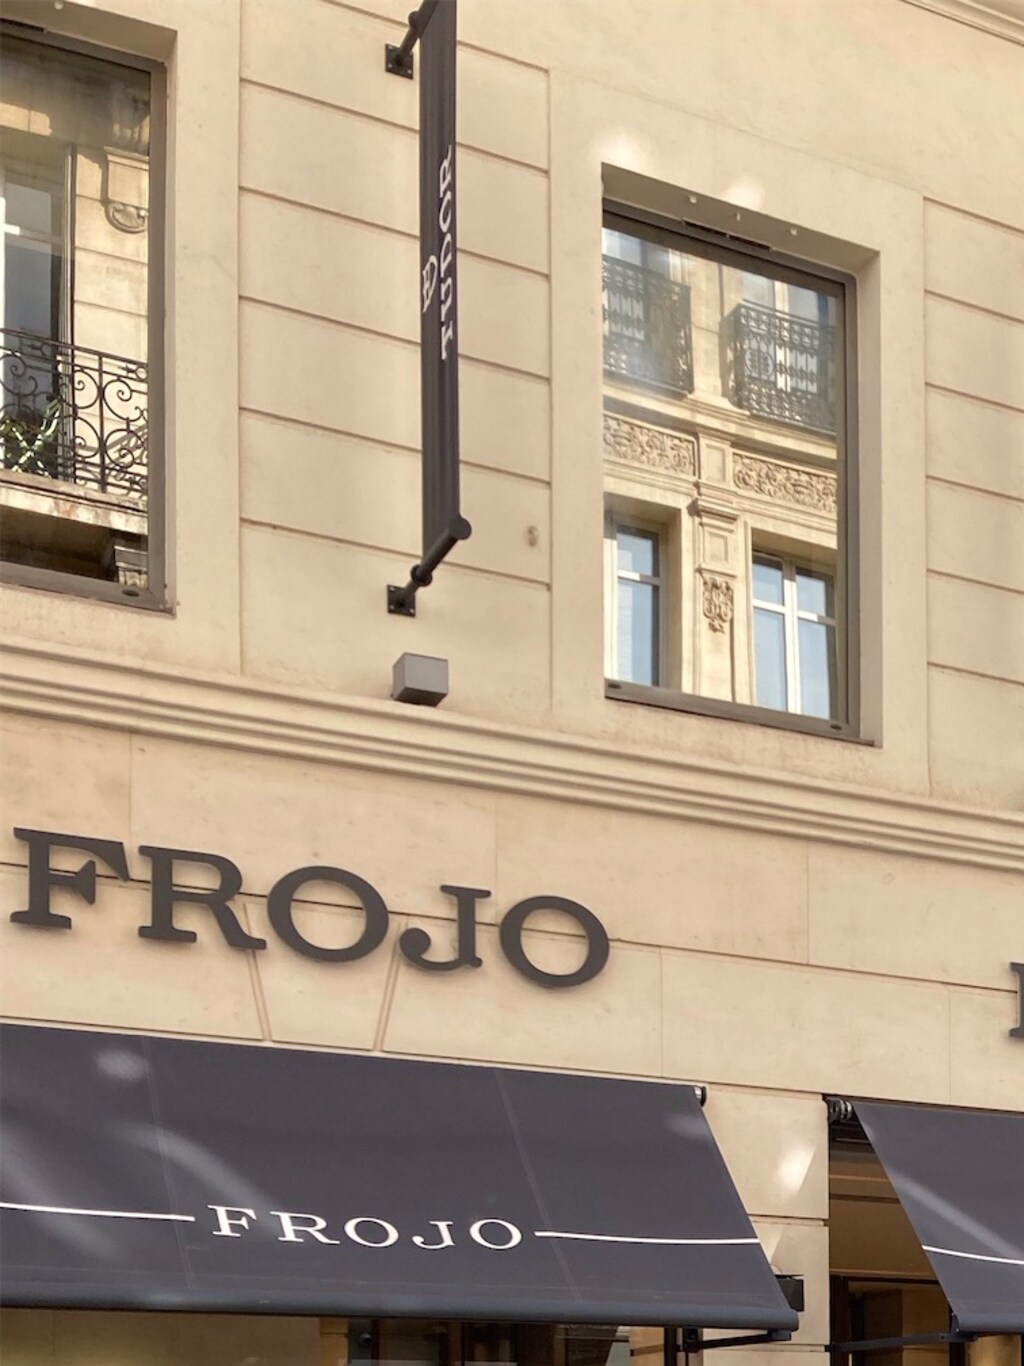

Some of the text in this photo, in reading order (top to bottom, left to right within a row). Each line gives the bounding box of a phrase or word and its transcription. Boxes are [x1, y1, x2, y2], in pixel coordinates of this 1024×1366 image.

[438, 144, 453, 361] TUDOR
[10, 827, 610, 989] FROJO
[207, 1205, 523, 1250] FROJO
